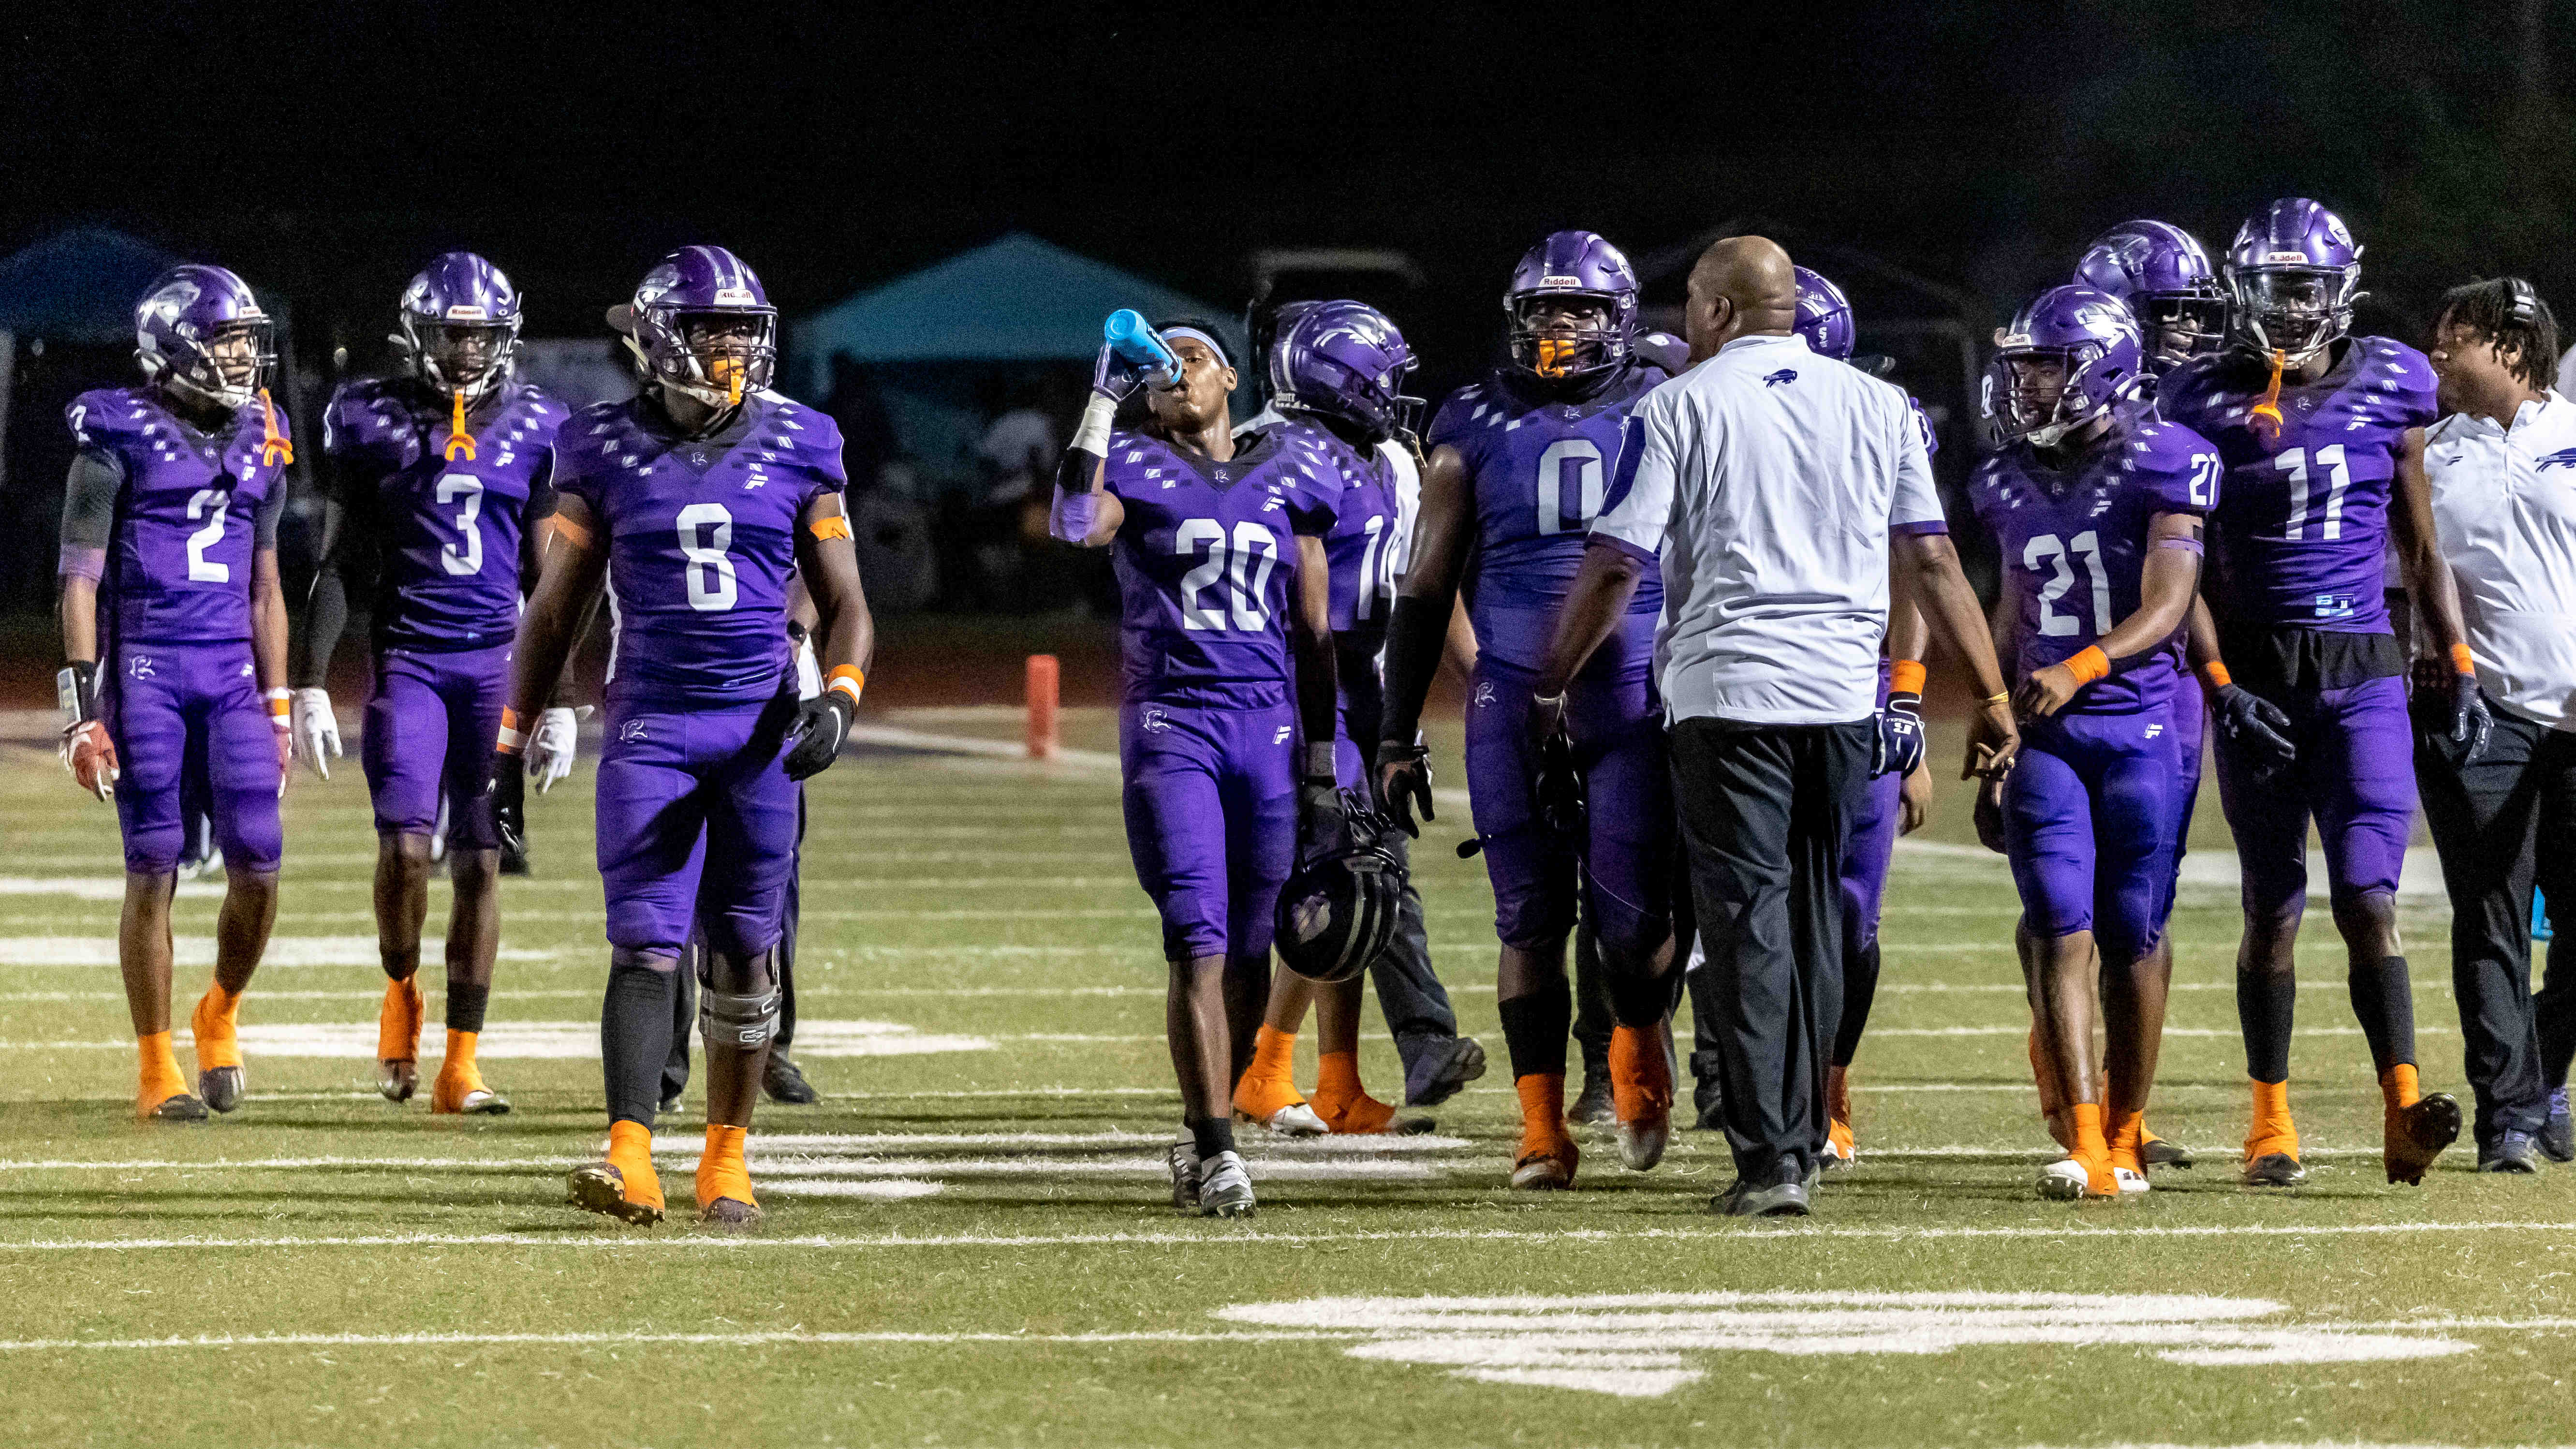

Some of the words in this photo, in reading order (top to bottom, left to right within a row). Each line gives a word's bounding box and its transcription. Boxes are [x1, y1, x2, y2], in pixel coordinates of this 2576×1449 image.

[436, 474, 484, 576] 3
[1538, 439, 1604, 536] 0
[2189, 453, 2220, 506] 21
[2275, 444, 2351, 540] 11
[187, 488, 230, 583] 2
[676, 503, 739, 611] 8
[1176, 518, 1278, 632] 20
[2023, 530, 2113, 637] 21
